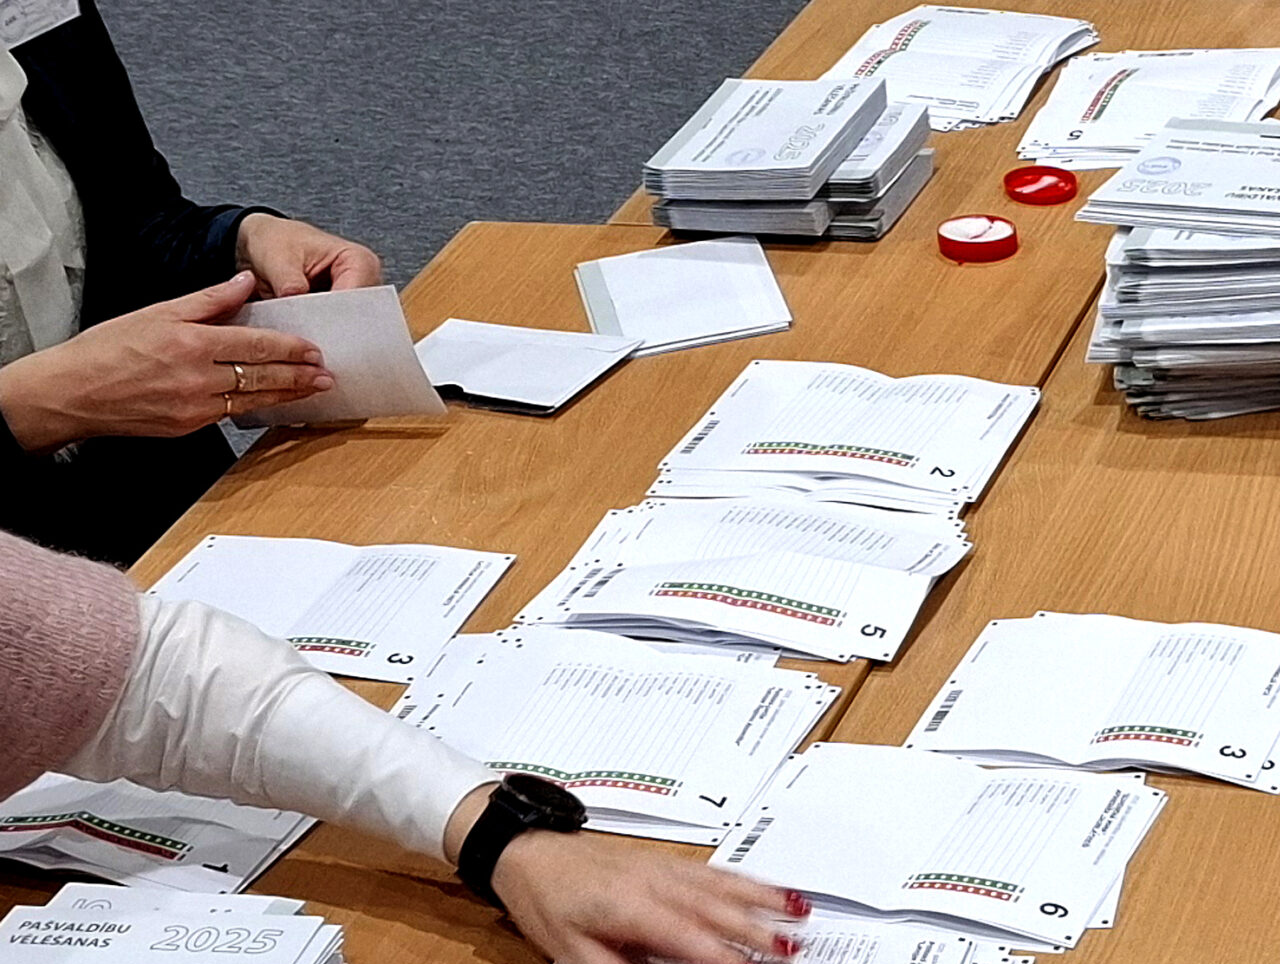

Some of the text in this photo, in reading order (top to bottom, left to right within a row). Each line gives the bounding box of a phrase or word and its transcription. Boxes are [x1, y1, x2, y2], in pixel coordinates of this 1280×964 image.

[1116, 178, 1212, 197] 2025
[930, 466, 956, 479] 2
[860, 623, 887, 640] 5
[387, 653, 414, 665] 3
[1219, 744, 1247, 760] 3
[699, 794, 728, 809] 7
[1039, 902, 1070, 919] 6
[9, 934, 112, 948] VĒLĒŠANAS
[18, 920, 284, 955] PAŠVALDĪBU 2025
